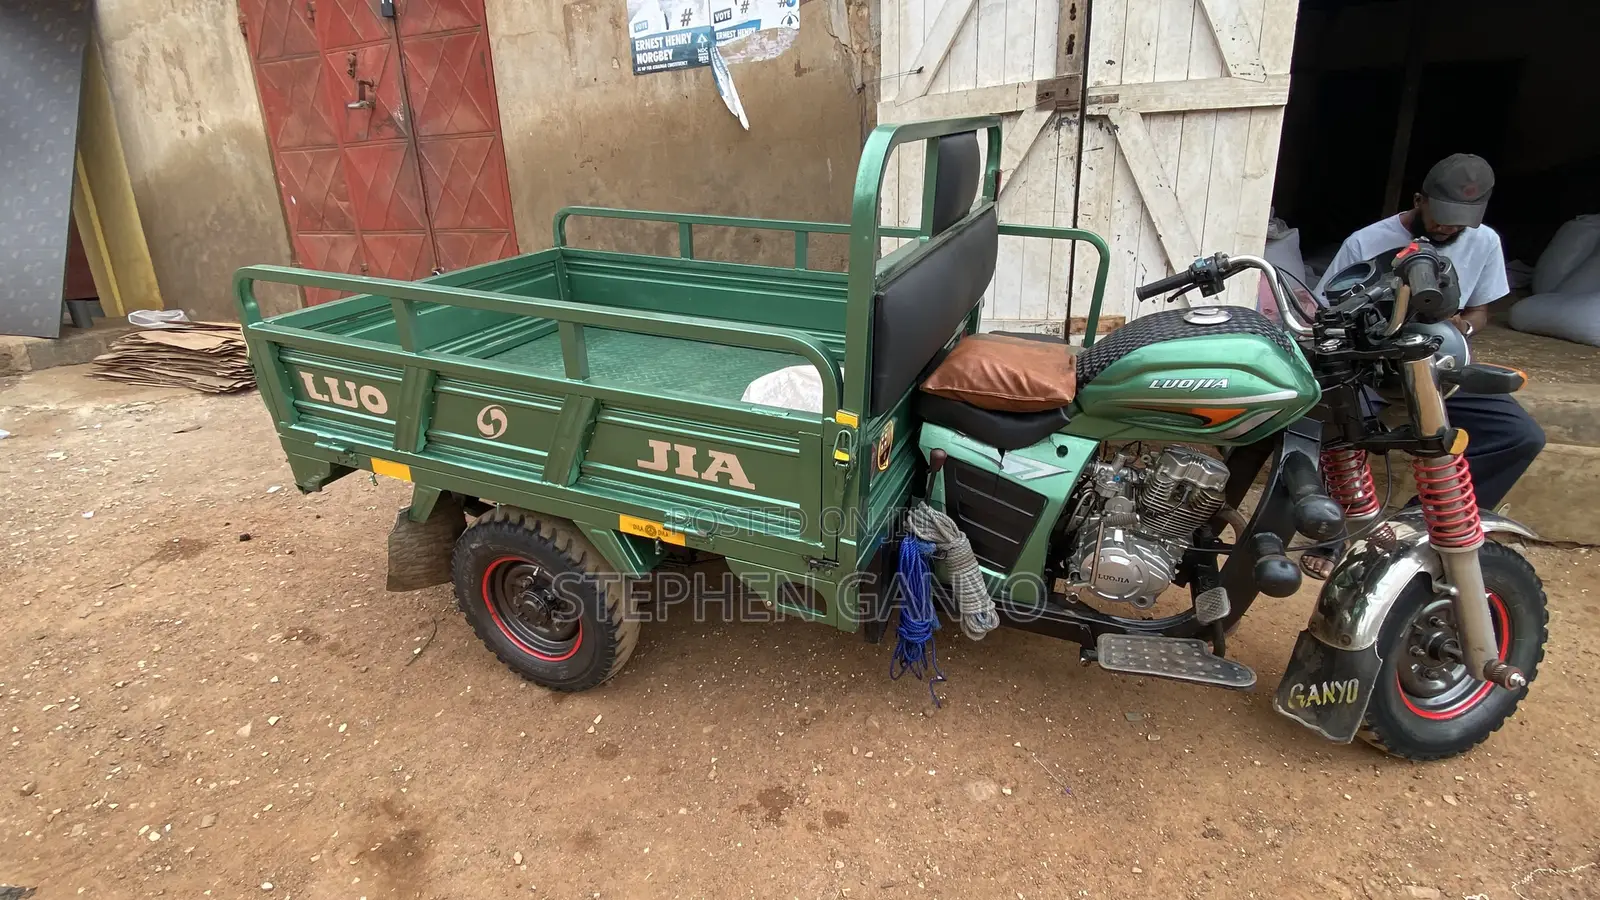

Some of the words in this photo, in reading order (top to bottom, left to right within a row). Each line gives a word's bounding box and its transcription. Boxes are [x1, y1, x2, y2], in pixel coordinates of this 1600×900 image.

[714, 10, 731, 22] VOTE
[635, 21, 648, 32] VOTE
[635, 37, 664, 52] ERNEST
[665, 32, 692, 47] HENRY
[636, 48, 674, 65] NORGBEY
[300, 371, 388, 415] LUO
[1148, 378, 1229, 393] LUOJIA
[637, 439, 756, 490] JIA
[1097, 573, 1130, 584] LUOJIA
[1287, 678, 1360, 710] GANYO
